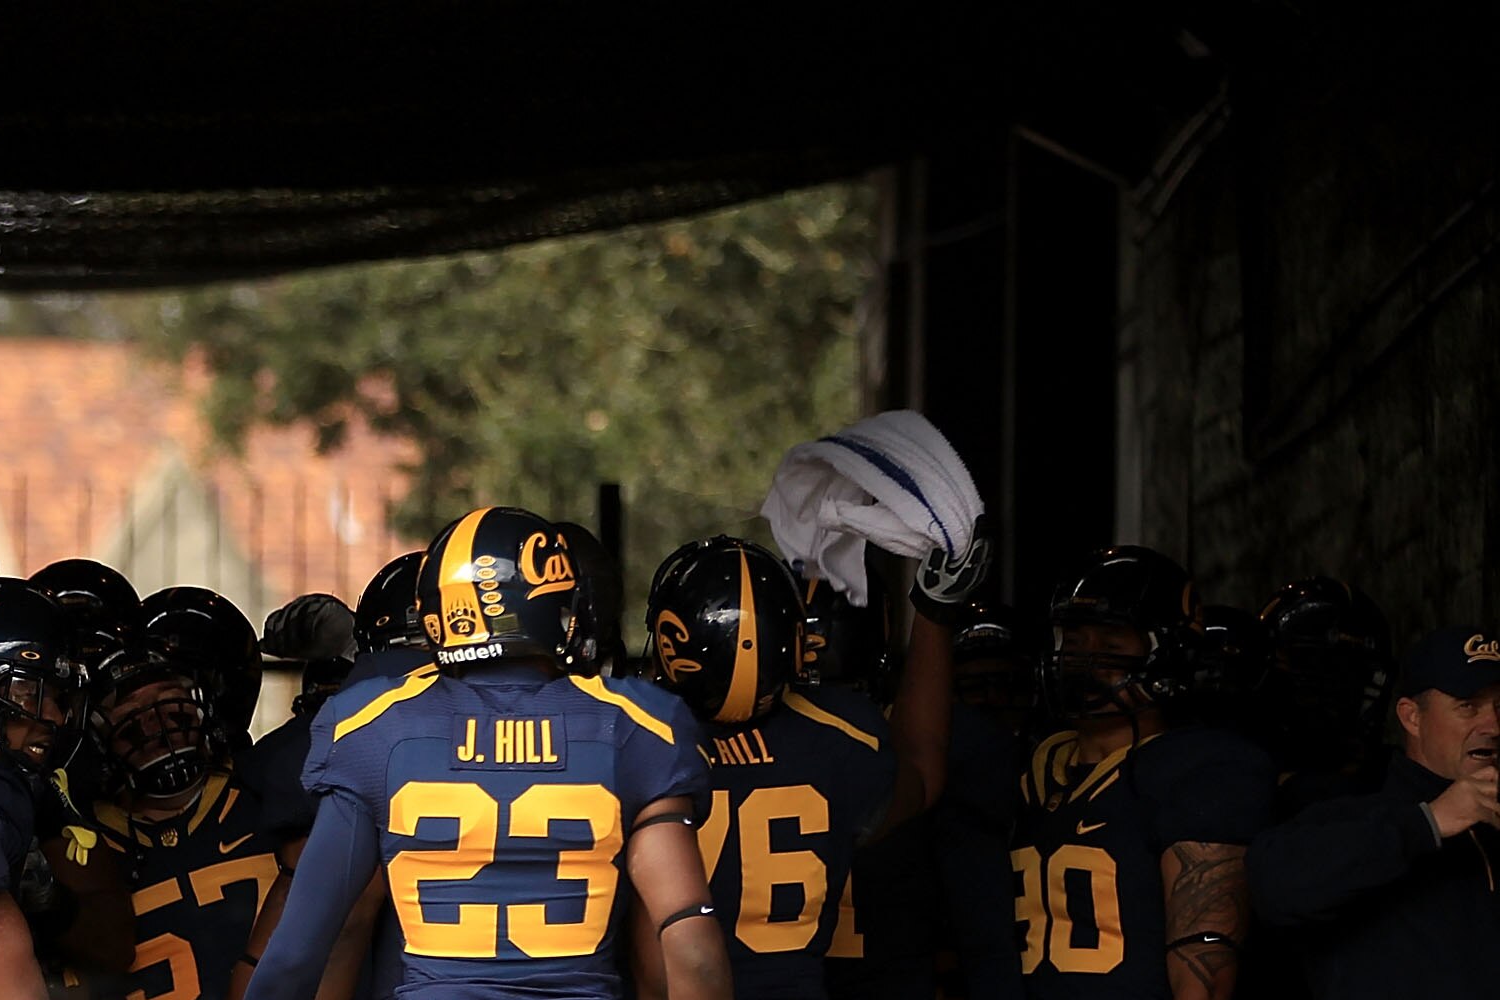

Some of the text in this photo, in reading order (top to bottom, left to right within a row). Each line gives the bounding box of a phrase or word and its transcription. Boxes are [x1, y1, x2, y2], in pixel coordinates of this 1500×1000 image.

[456, 621, 471, 635] 23
[654, 609, 702, 683] Cal
[437, 643, 504, 666] Riddell
[457, 718, 558, 764] J. HILL
[712, 728, 775, 765] HILL
[387, 781, 624, 958] 23
